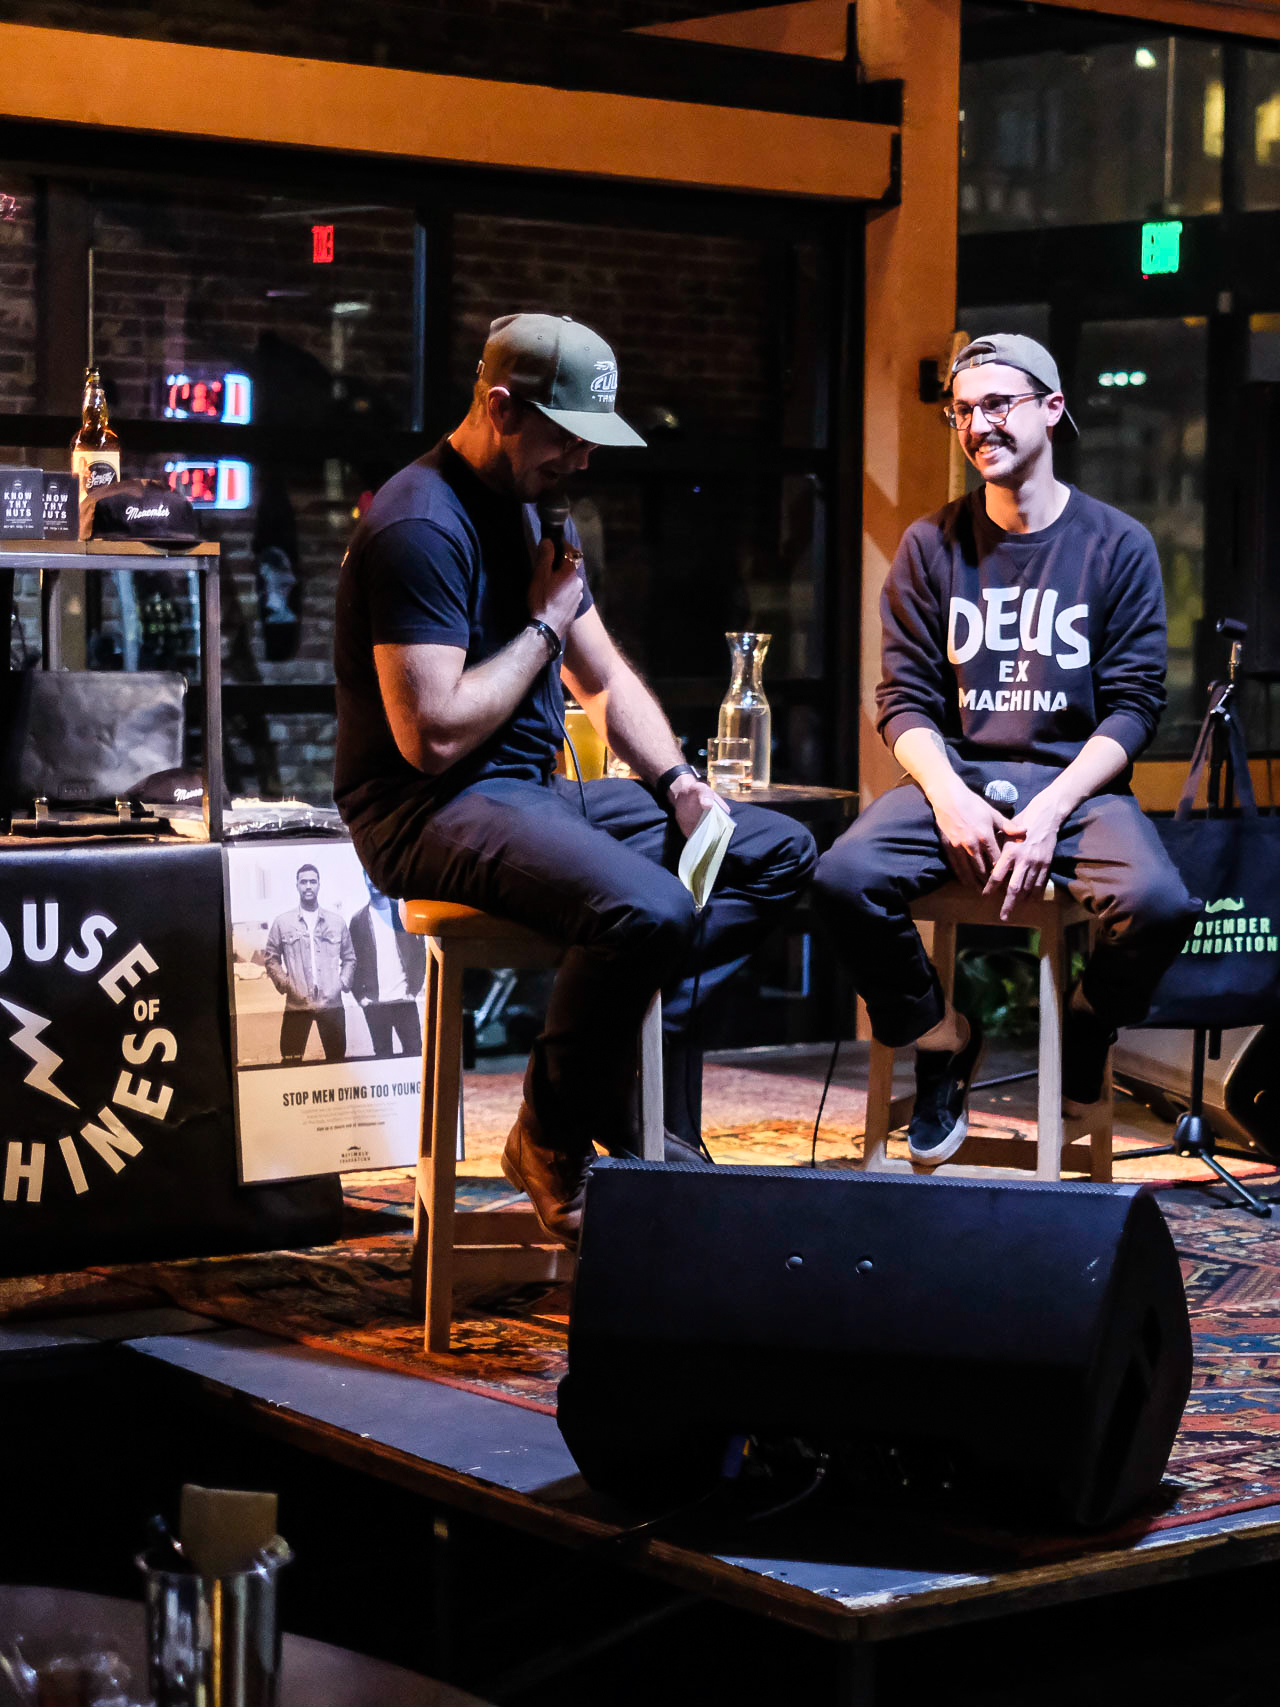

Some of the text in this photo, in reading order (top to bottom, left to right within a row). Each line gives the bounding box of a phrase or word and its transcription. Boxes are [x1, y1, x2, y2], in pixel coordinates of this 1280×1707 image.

[4, 492, 32, 500] KNOW
[9, 500, 27, 509] THY
[6, 509, 32, 517] NUTS
[44, 502, 63, 511] THY
[947, 586, 1091, 670] DEUS
[998, 660, 1030, 683] EX
[958, 687, 1068, 712] MACHINA
[1193, 917, 1271, 937] OVEMBER
[1180, 936, 1279, 954] UNDATION
[133, 999, 160, 1022] OF
[282, 1081, 421, 1107] STOP MEN DYING TOO YOUNG
